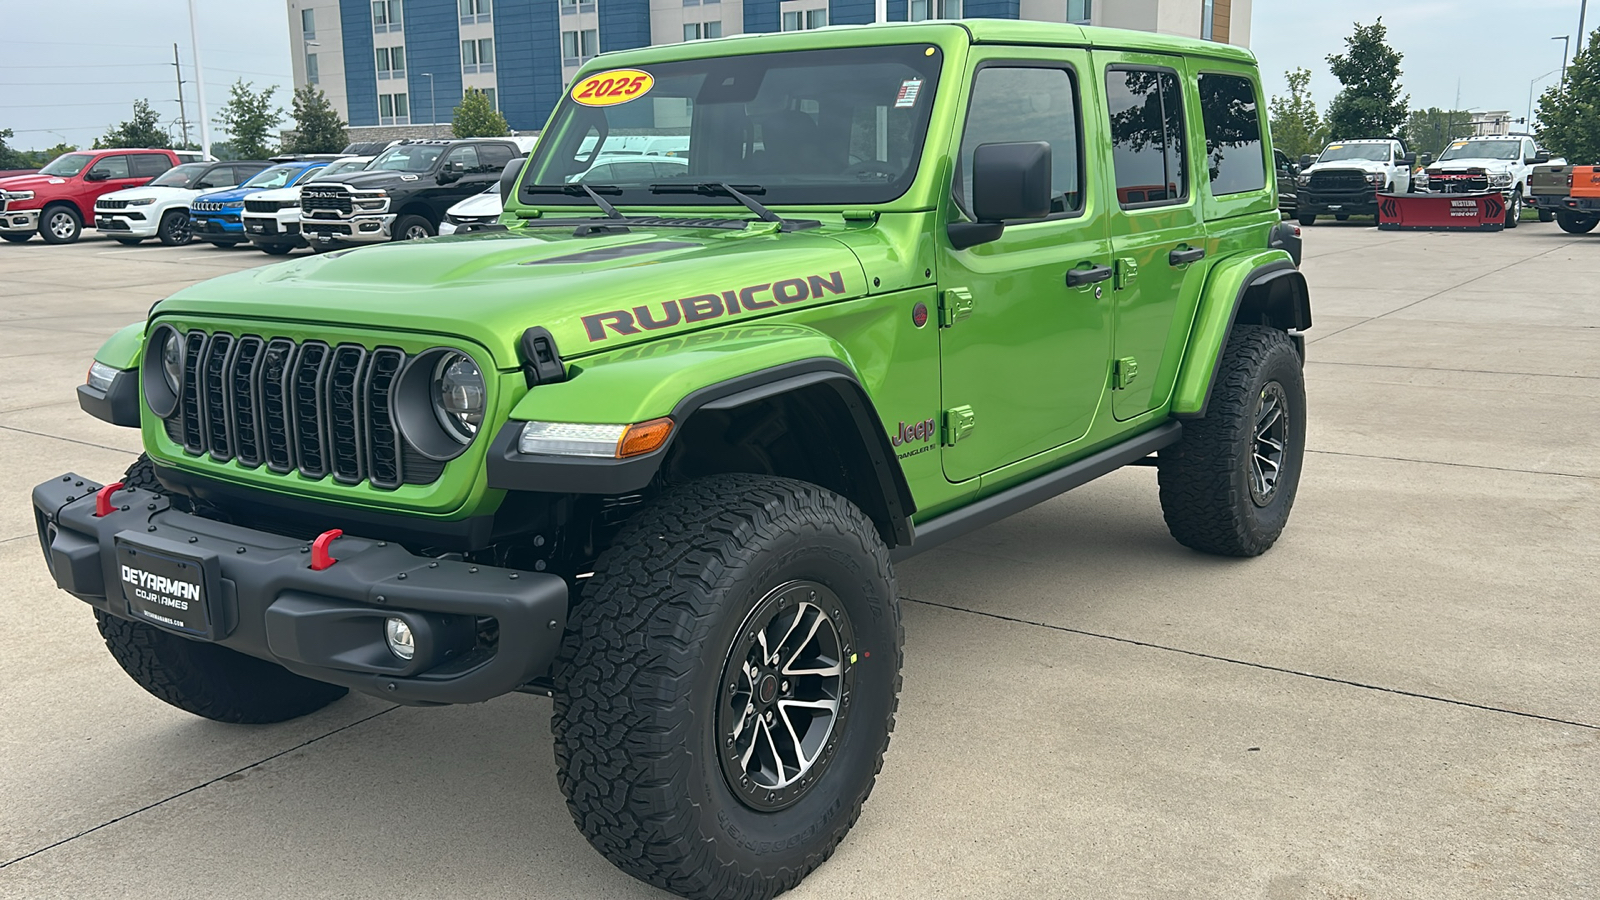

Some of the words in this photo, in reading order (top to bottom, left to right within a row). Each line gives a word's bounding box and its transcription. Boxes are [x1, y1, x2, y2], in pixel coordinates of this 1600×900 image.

[578, 76, 647, 98] 2025
[580, 271, 846, 342] RUBICON
[892, 418, 935, 447] Jeep
[898, 445, 929, 460] RANGLER
[121, 565, 200, 601] DEYARMAN
